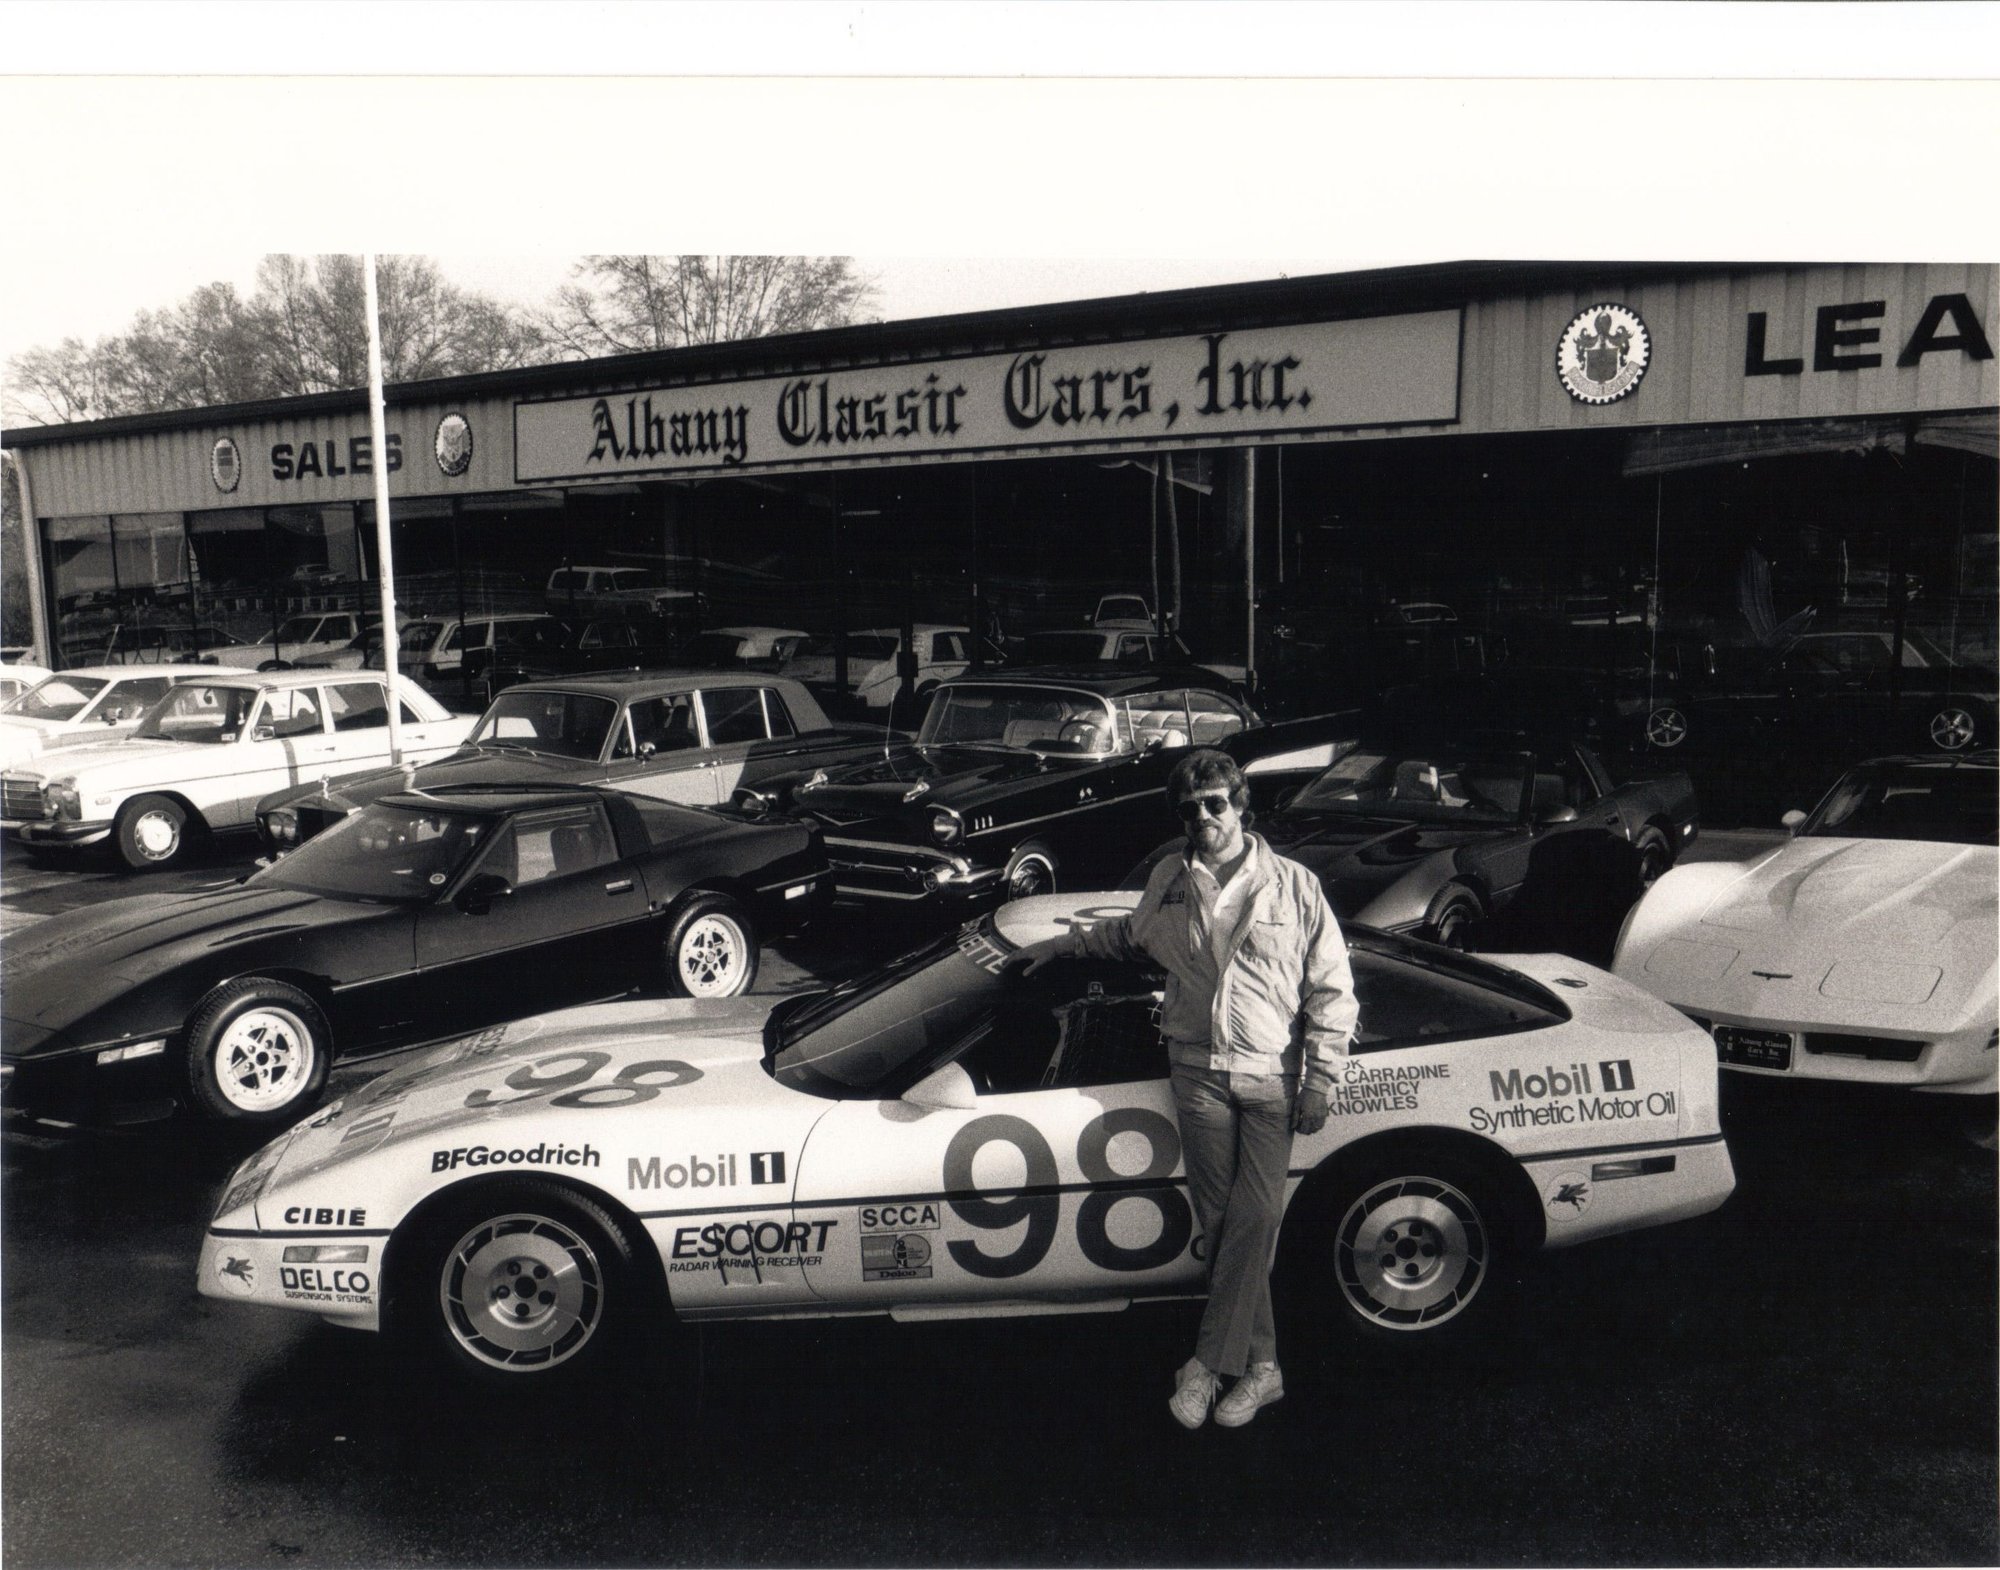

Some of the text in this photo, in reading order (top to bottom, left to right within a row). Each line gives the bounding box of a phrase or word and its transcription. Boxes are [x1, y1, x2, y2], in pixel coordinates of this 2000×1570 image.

[1745, 293, 1994, 377] LEA
[586, 333, 1312, 465] Albany Classic Cars, Inc.
[271, 433, 402, 480] SALES
[464, 1051, 705, 1109] 98
[1336, 1081, 1420, 1100] HEINRICY
[1344, 1064, 1450, 1084] CARRADINE
[1489, 1063, 1592, 1101] Mobil
[1327, 1096, 1418, 1116] KNOWLES
[1469, 1091, 1676, 1135] Synthetic Motor Oil
[432, 1143, 601, 1173] BFGoodrich
[627, 1153, 737, 1190] Mobil
[943, 1107, 1193, 1278] 98
[862, 1205, 937, 1228] SCCA
[672, 1220, 838, 1259] ESCORT
[280, 1267, 370, 1294] DELCO
[669, 1256, 822, 1272] RADAR WARNING RECEIVER
[285, 1290, 373, 1304] SUSPENSION SYSTEMS
